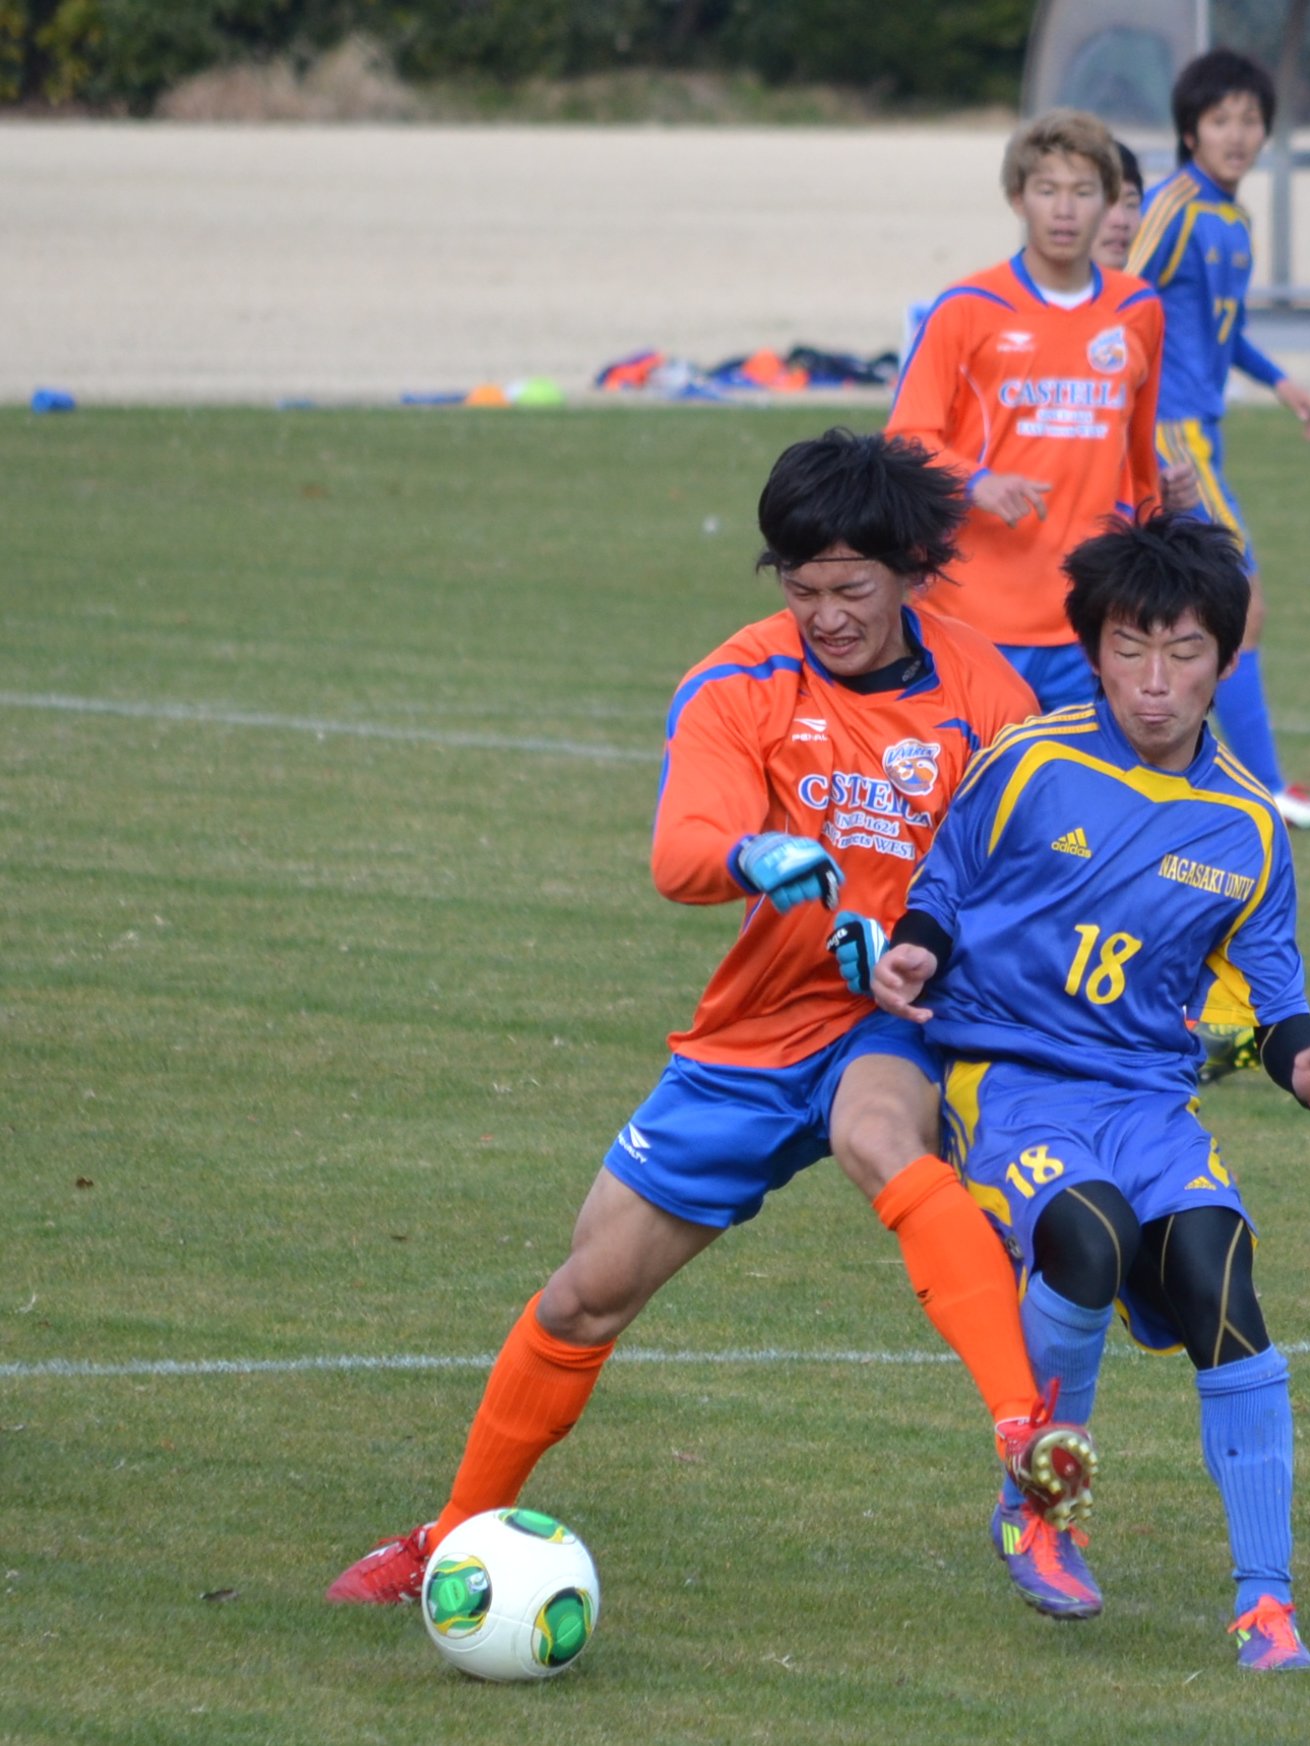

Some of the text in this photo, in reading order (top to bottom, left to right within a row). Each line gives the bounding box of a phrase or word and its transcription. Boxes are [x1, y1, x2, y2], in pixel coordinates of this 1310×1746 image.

[866, 818, 899, 836] 1624
[1051, 841, 1092, 859] adidas
[1158, 854, 1255, 902] NAGASAKI UNIV
[1064, 924, 1143, 1005] 18
[1005, 1145, 1064, 1199] 18
